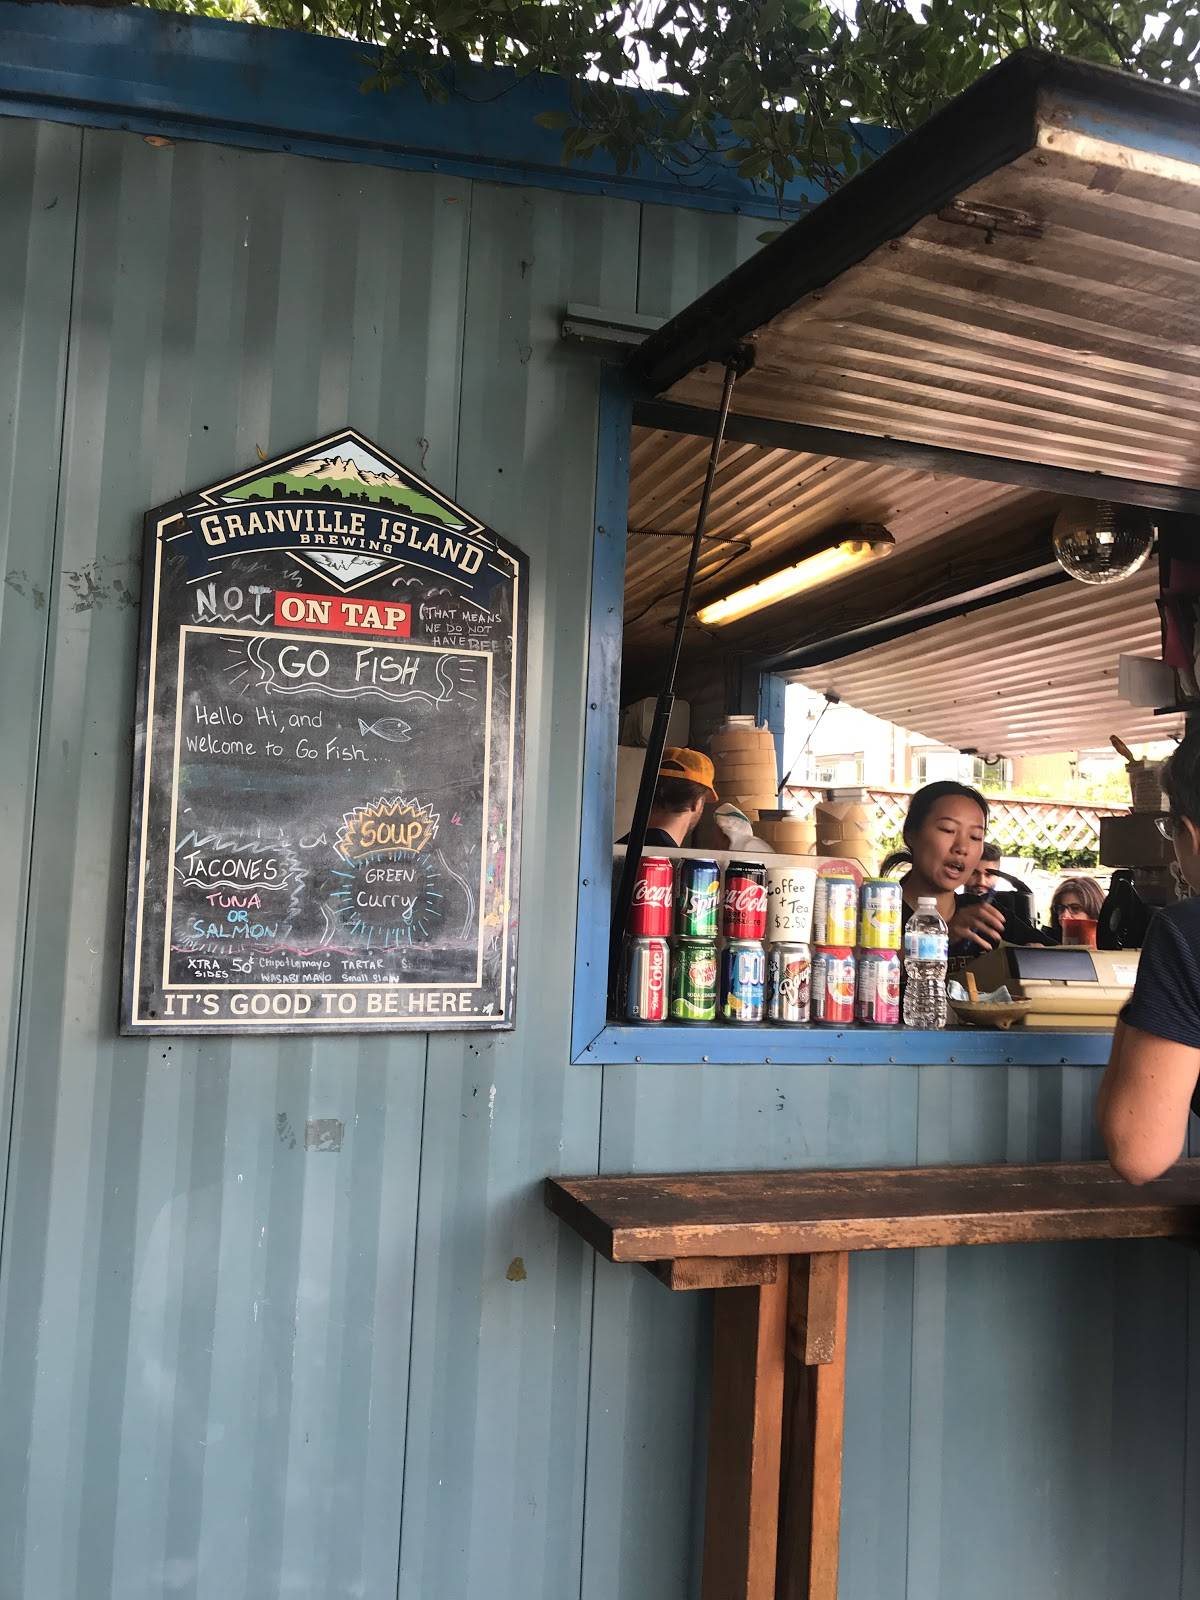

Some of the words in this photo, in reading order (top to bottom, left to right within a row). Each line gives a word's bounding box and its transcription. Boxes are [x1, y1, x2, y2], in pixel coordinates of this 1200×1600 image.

[200, 509, 366, 547] GRANVILLE
[379, 518, 485, 576] ISLAND
[300, 534, 394, 554] BREWING
[196, 582, 273, 617] NOT
[280, 597, 331, 624] ON
[341, 602, 406, 631] TAP
[462, 611, 502, 624] MEANS
[425, 623, 441, 633] WE
[446, 623, 463, 633] DO
[467, 623, 492, 634] NOT
[432, 636, 466, 647] HAVE
[278, 645, 330, 678] GO
[355, 647, 420, 685] FISH
[195, 705, 243, 726] Hello
[289, 711, 323, 728] and
[265, 742, 284, 756] to
[295, 739, 319, 759] Go
[183, 850, 278, 880] TACONES
[365, 868, 416, 883] GREEN
[767, 879, 805, 896] Coffee
[206, 892, 261, 909] TUNA
[356, 891, 418, 920] Curry
[789, 900, 809, 914] Tea
[227, 910, 249, 923] OR
[192, 919, 278, 940] SALMON
[187, 959, 220, 970] XTRA
[341, 959, 384, 970] TARTAR
[649, 953, 663, 991] Coke
[194, 970, 229, 979] SIDES
[260, 973, 299, 983] WASABI
[302, 972, 332, 984] MAYO
[230, 994, 311, 1015] GOOD
[321, 994, 356, 1014] TO
[367, 993, 401, 1013] BE
[408, 993, 479, 1013] HERE.
